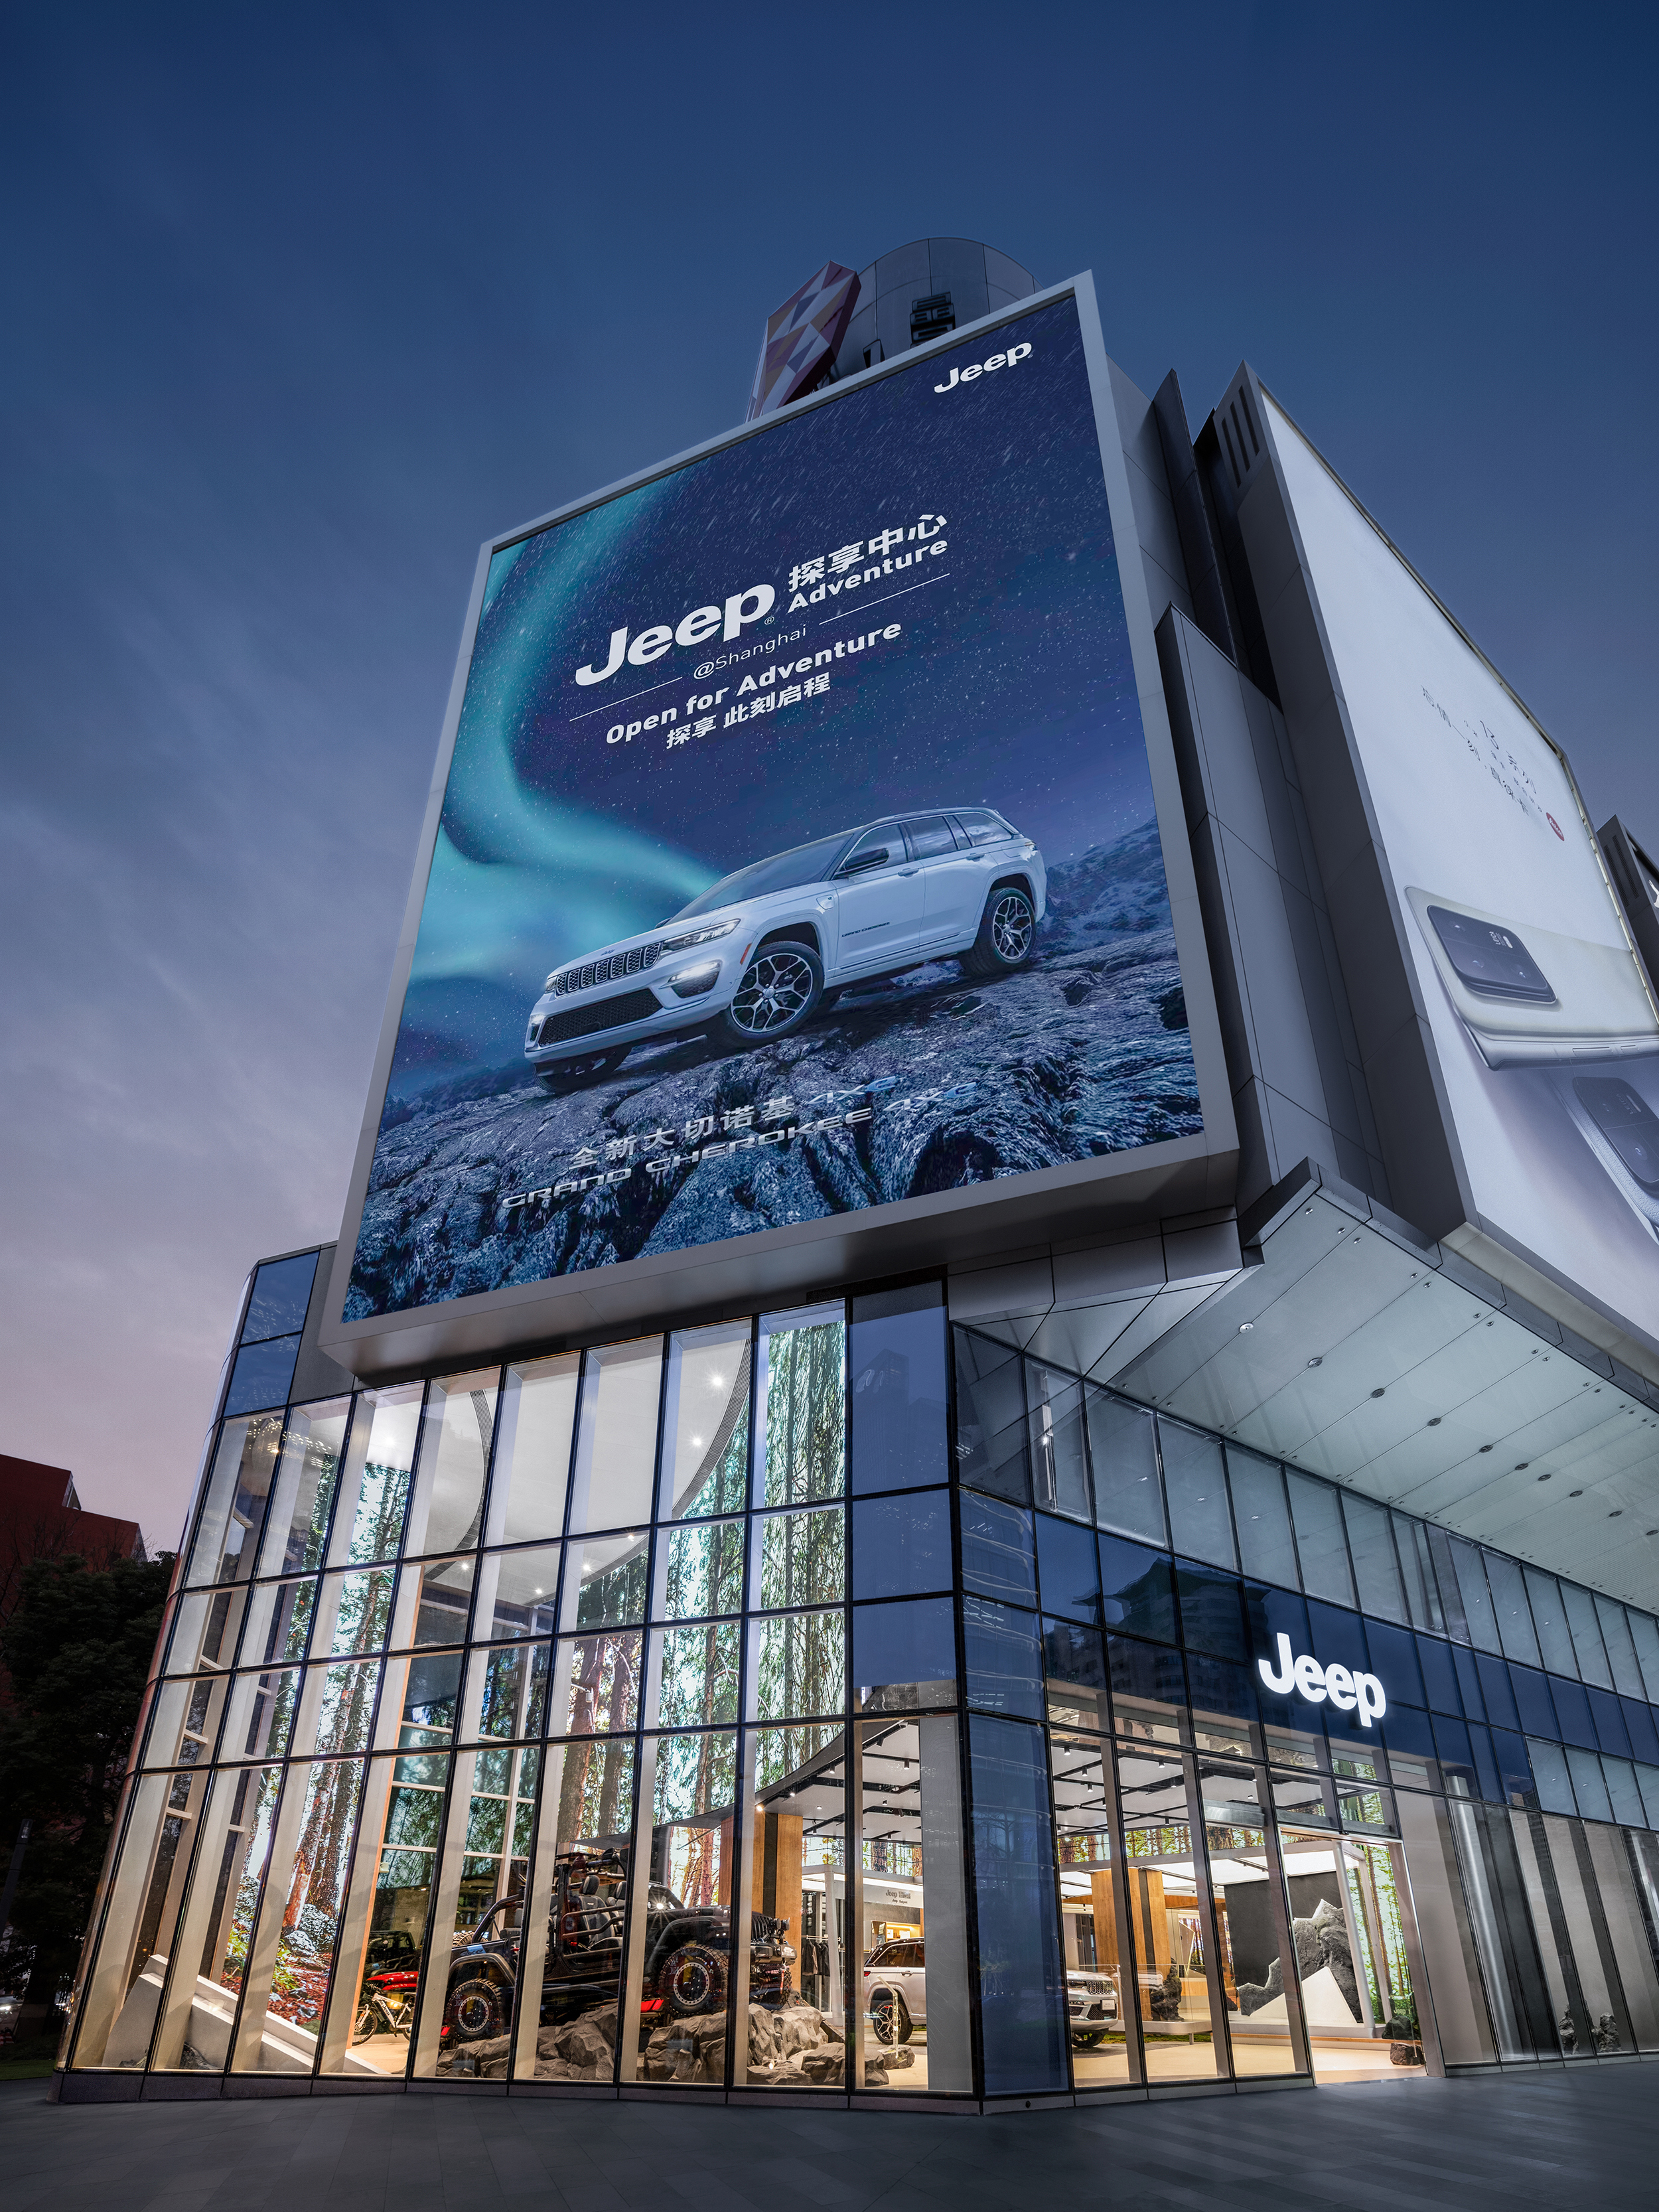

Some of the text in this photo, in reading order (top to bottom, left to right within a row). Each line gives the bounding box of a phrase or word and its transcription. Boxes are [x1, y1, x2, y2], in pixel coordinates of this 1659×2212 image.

[934, 342, 1032, 393] Jeep
[787, 540, 948, 614] Adventure
[788, 514, 948, 593] 探享中心
[575, 584, 775, 686] Jeep
[693, 625, 807, 680] @Shanghai
[606, 623, 901, 744] Open for Adventure
[666, 672, 830, 749] 探享 此刻启程
[502, 1167, 632, 1209] GRAND
[646, 1108, 872, 1173] CHEROKEE
[569, 1095, 795, 1169] 全新大切诺基
[1258, 1632, 1386, 1728] Jeep
[885, 1889, 897, 1898] Jeep
